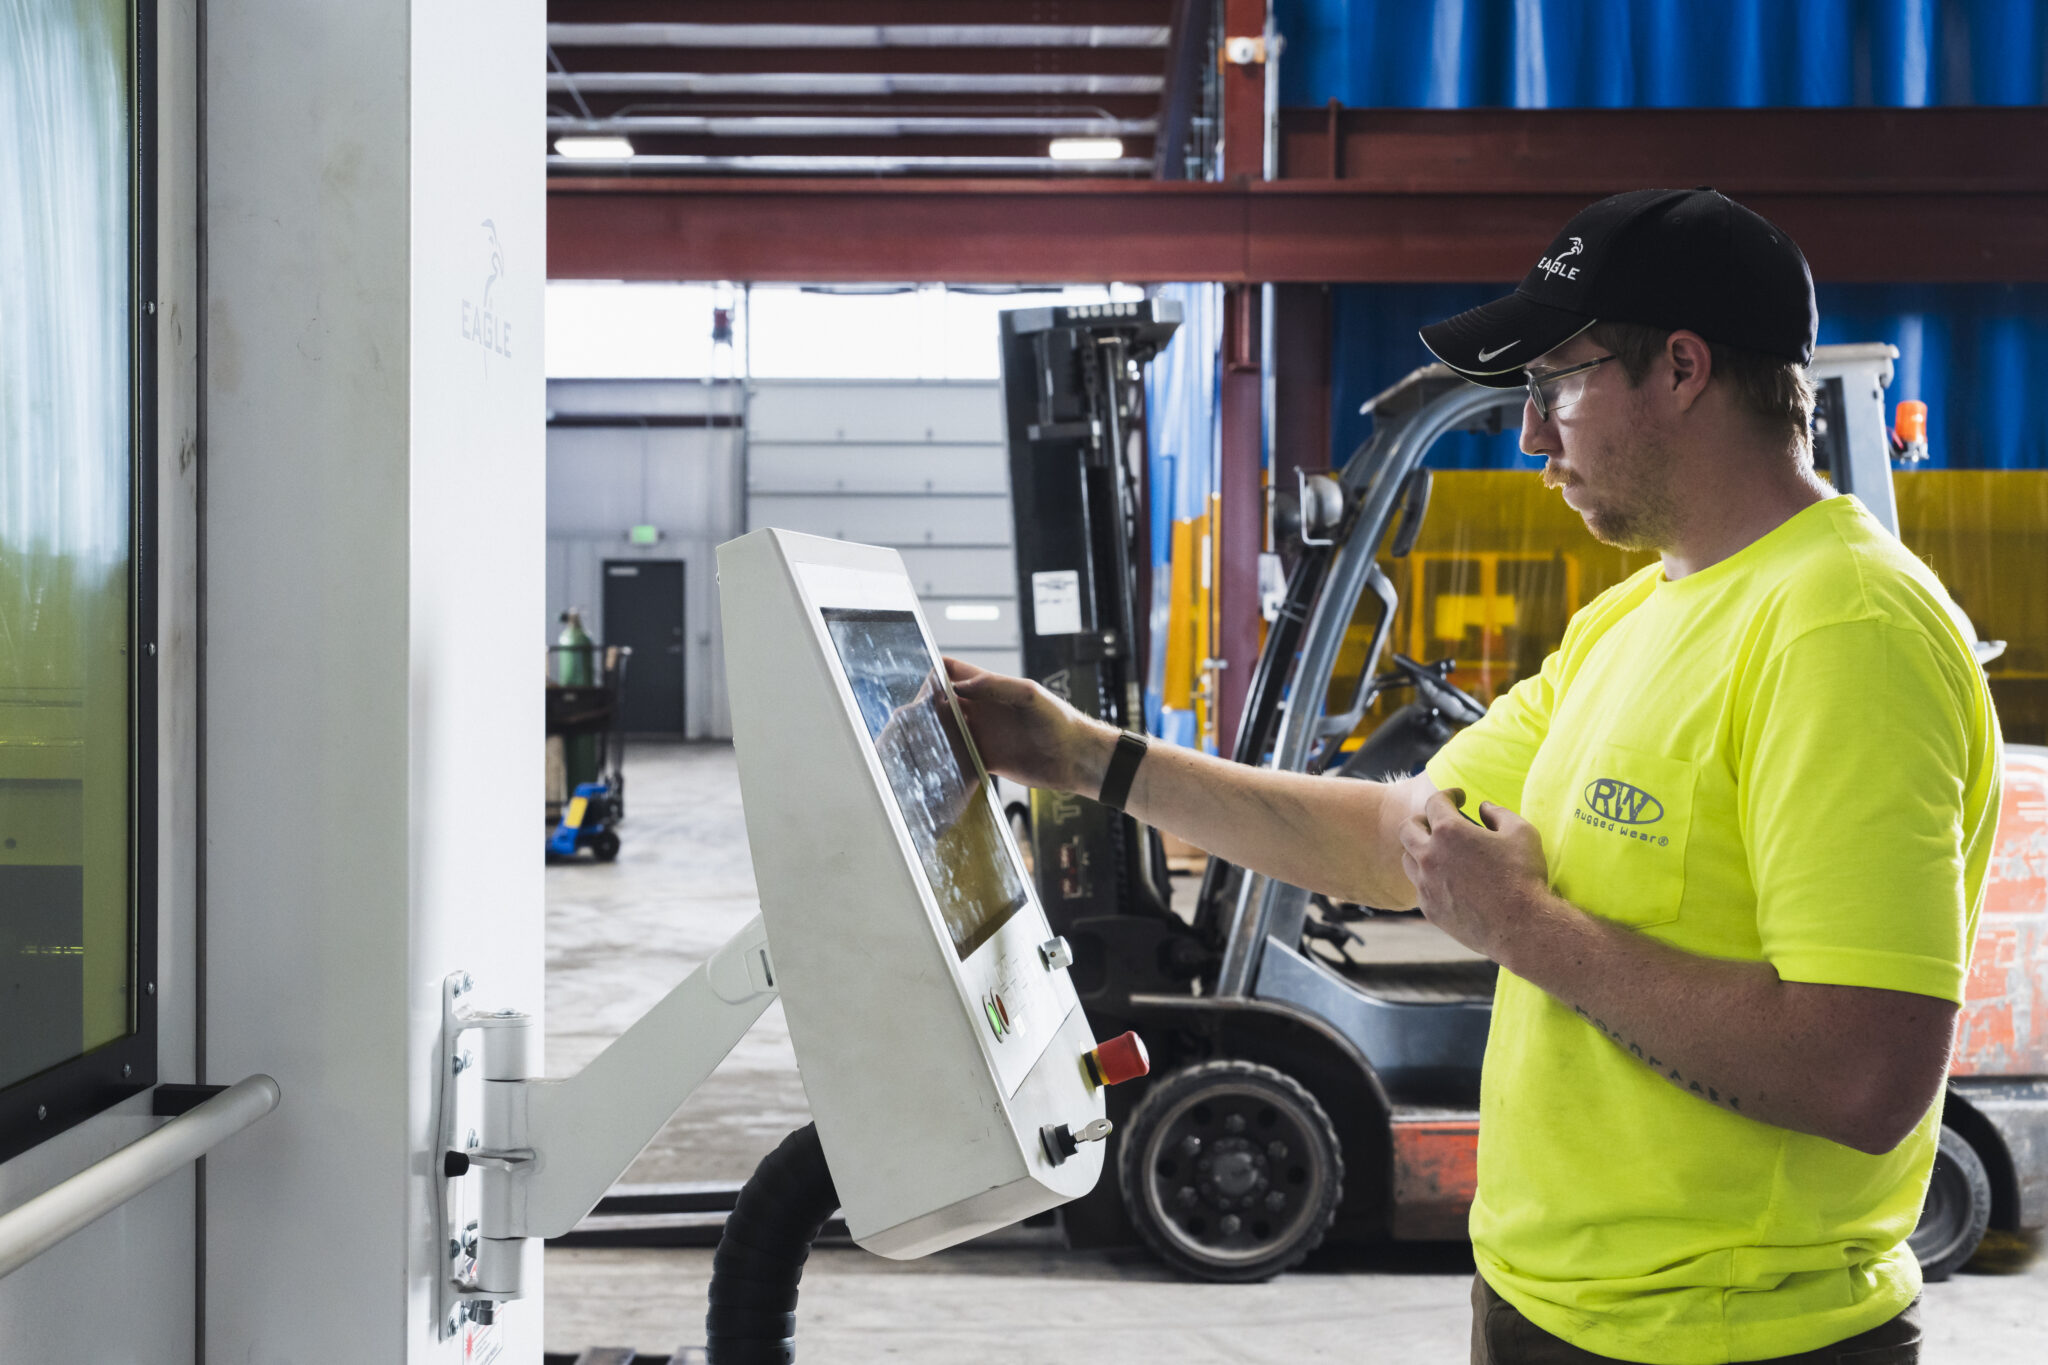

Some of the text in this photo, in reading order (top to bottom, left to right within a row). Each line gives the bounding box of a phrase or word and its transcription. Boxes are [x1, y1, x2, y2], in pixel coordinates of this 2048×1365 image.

[1537, 256, 1580, 280] EAGLE
[462, 299, 512, 359] EAGLE
[1591, 780, 1650, 821] RW
[1574, 808, 1615, 831] Rugged
